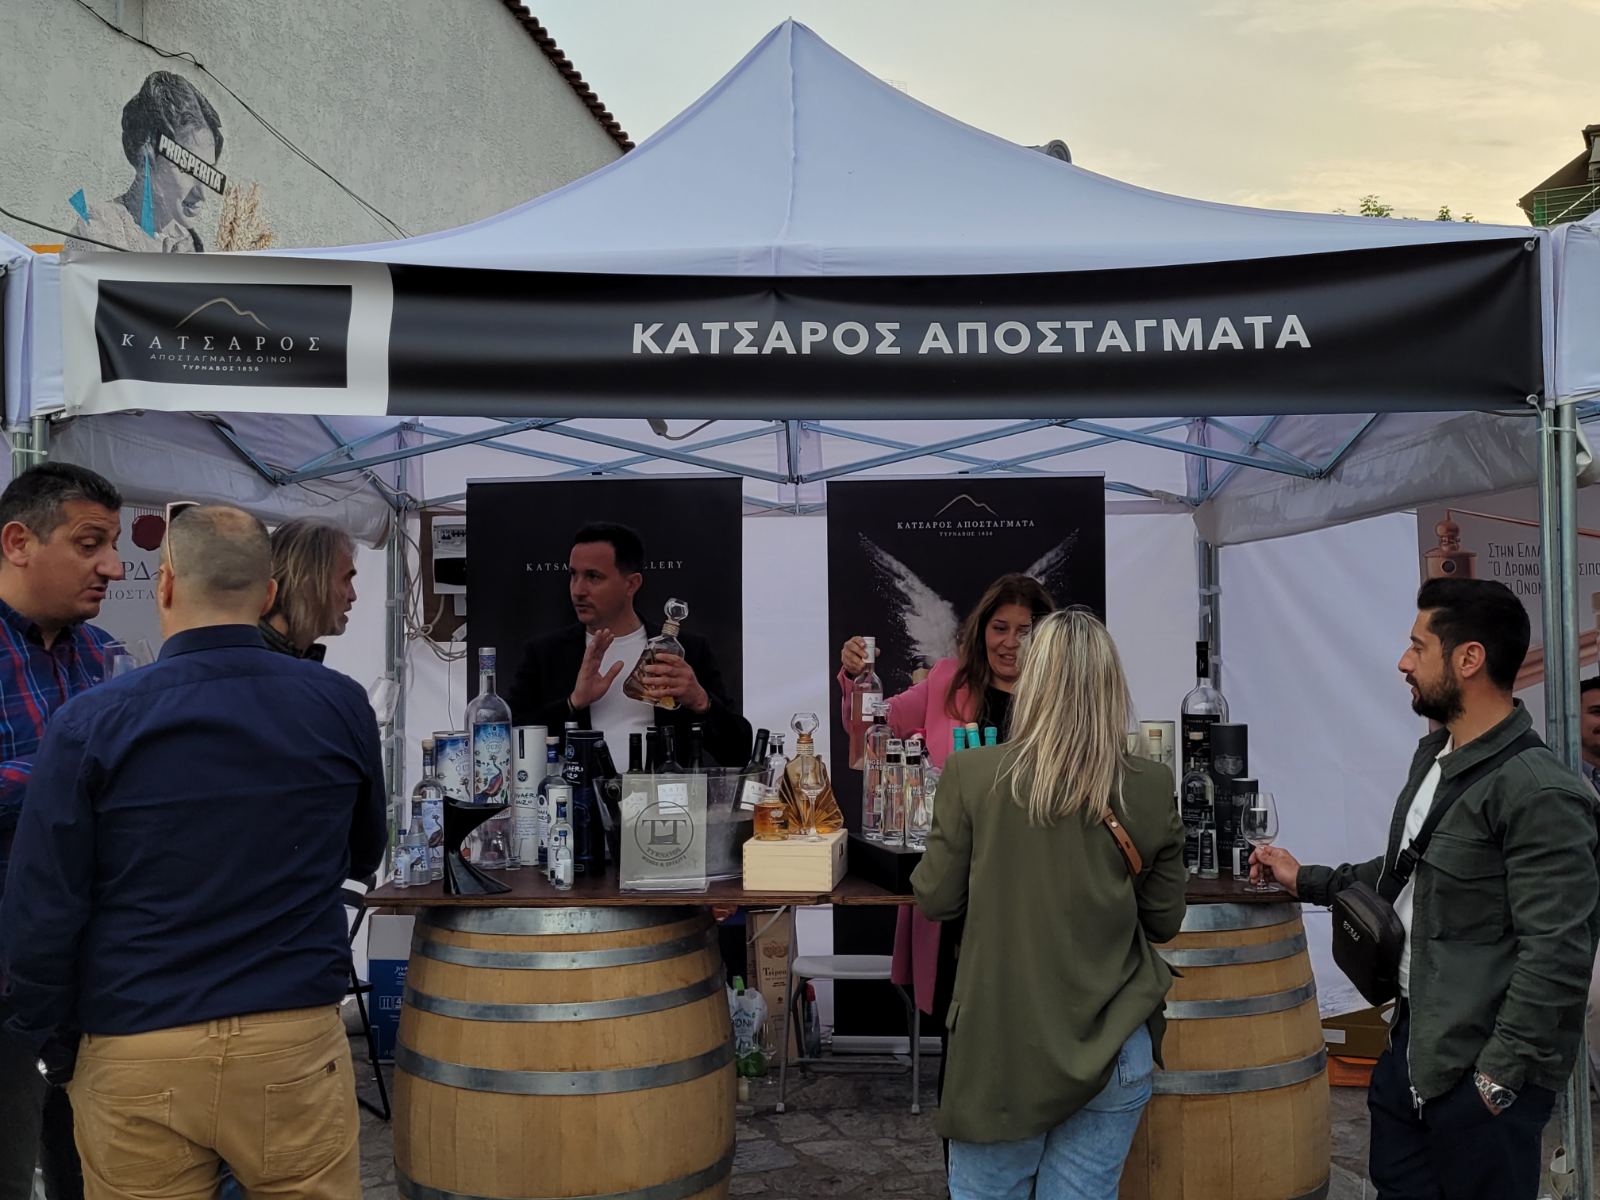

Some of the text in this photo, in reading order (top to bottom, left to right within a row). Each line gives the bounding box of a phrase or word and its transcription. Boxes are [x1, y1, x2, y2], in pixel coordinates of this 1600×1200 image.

[632, 314, 1311, 355] ΚΑΤΣΑΡΟΣ ΑΠΟΣΤΑΓΜΑΤΑ
[121, 333, 320, 351] ΚΑΤΣΑΡΟΣ
[150, 353, 242, 363] ΑΠΟΣΤΑΓΜΑΤΑ
[182, 364, 235, 372] ΤΥΡΝΑΒΟΣ
[897, 520, 1035, 529] ΚΑΤΣΑΡΟΣ ΑΠΟΣΤΑΓΜΑΤΑ
[526, 562, 568, 572] KATSA
[1505, 561, 1540, 577] ΔΡΟΜΟ
